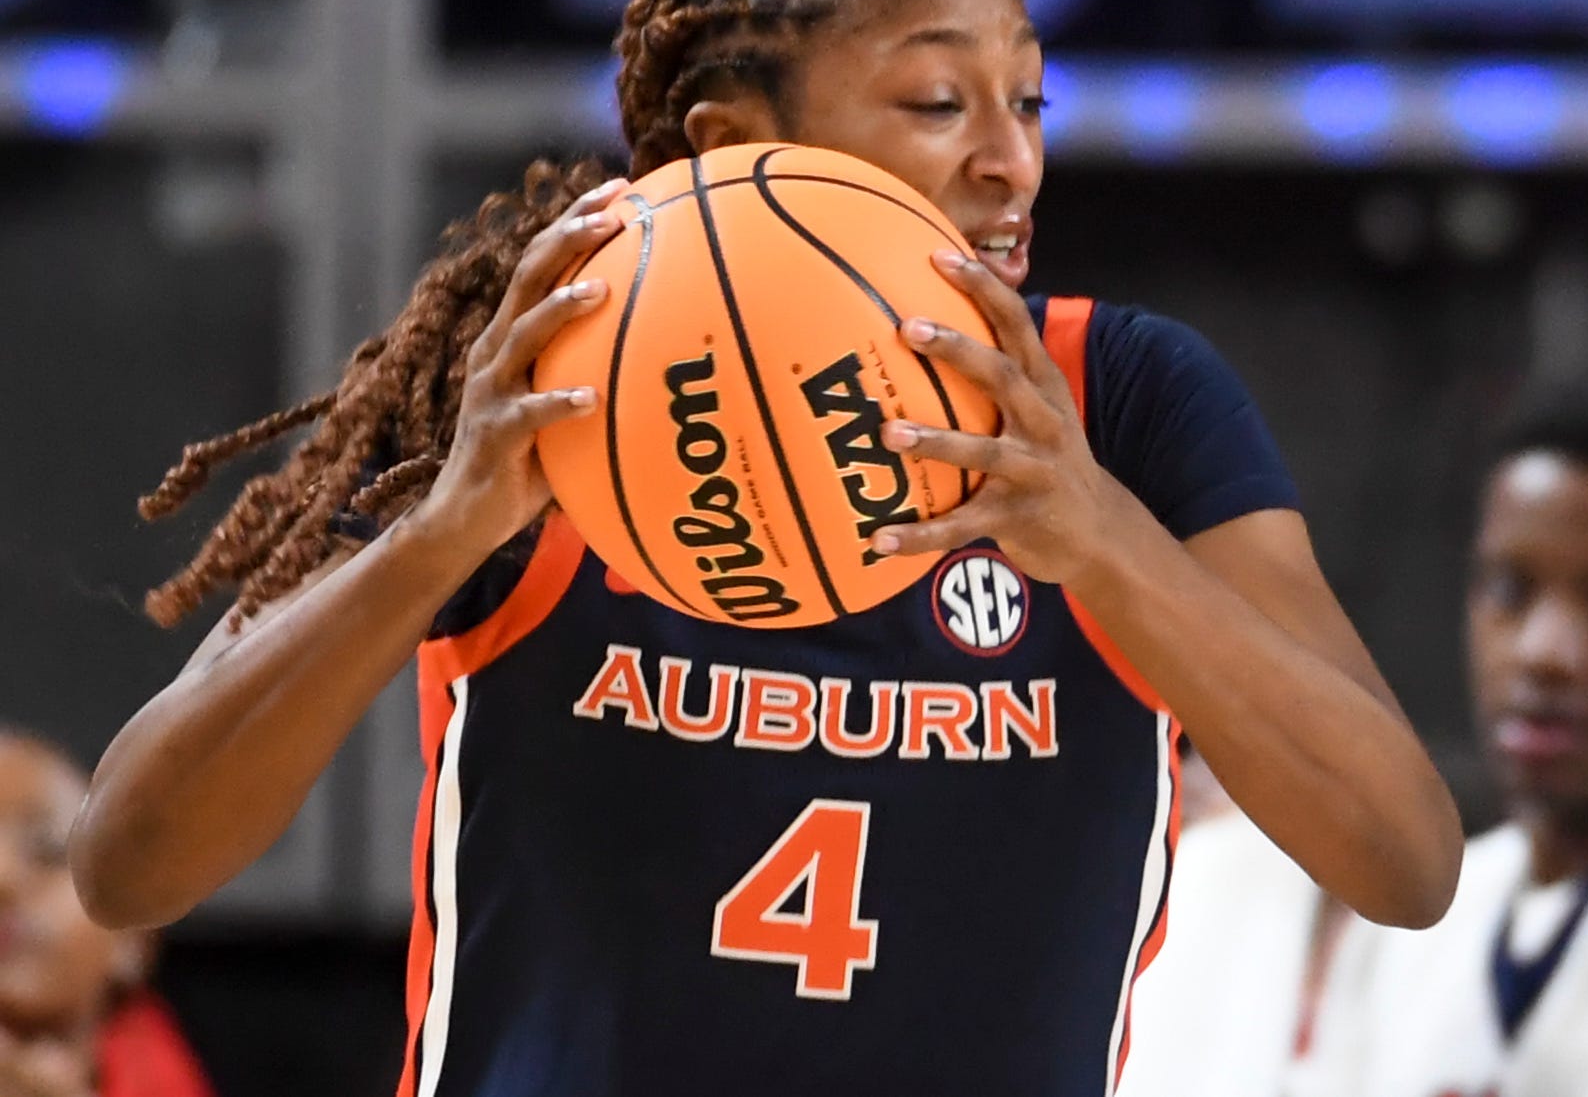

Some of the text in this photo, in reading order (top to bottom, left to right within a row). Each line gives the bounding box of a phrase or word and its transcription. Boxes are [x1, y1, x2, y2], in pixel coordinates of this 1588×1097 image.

[663, 350, 802, 622] Wilson
[940, 556, 1022, 649] SEC
[573, 643, 1059, 760] AUBURN
[710, 798, 879, 1001] 4
